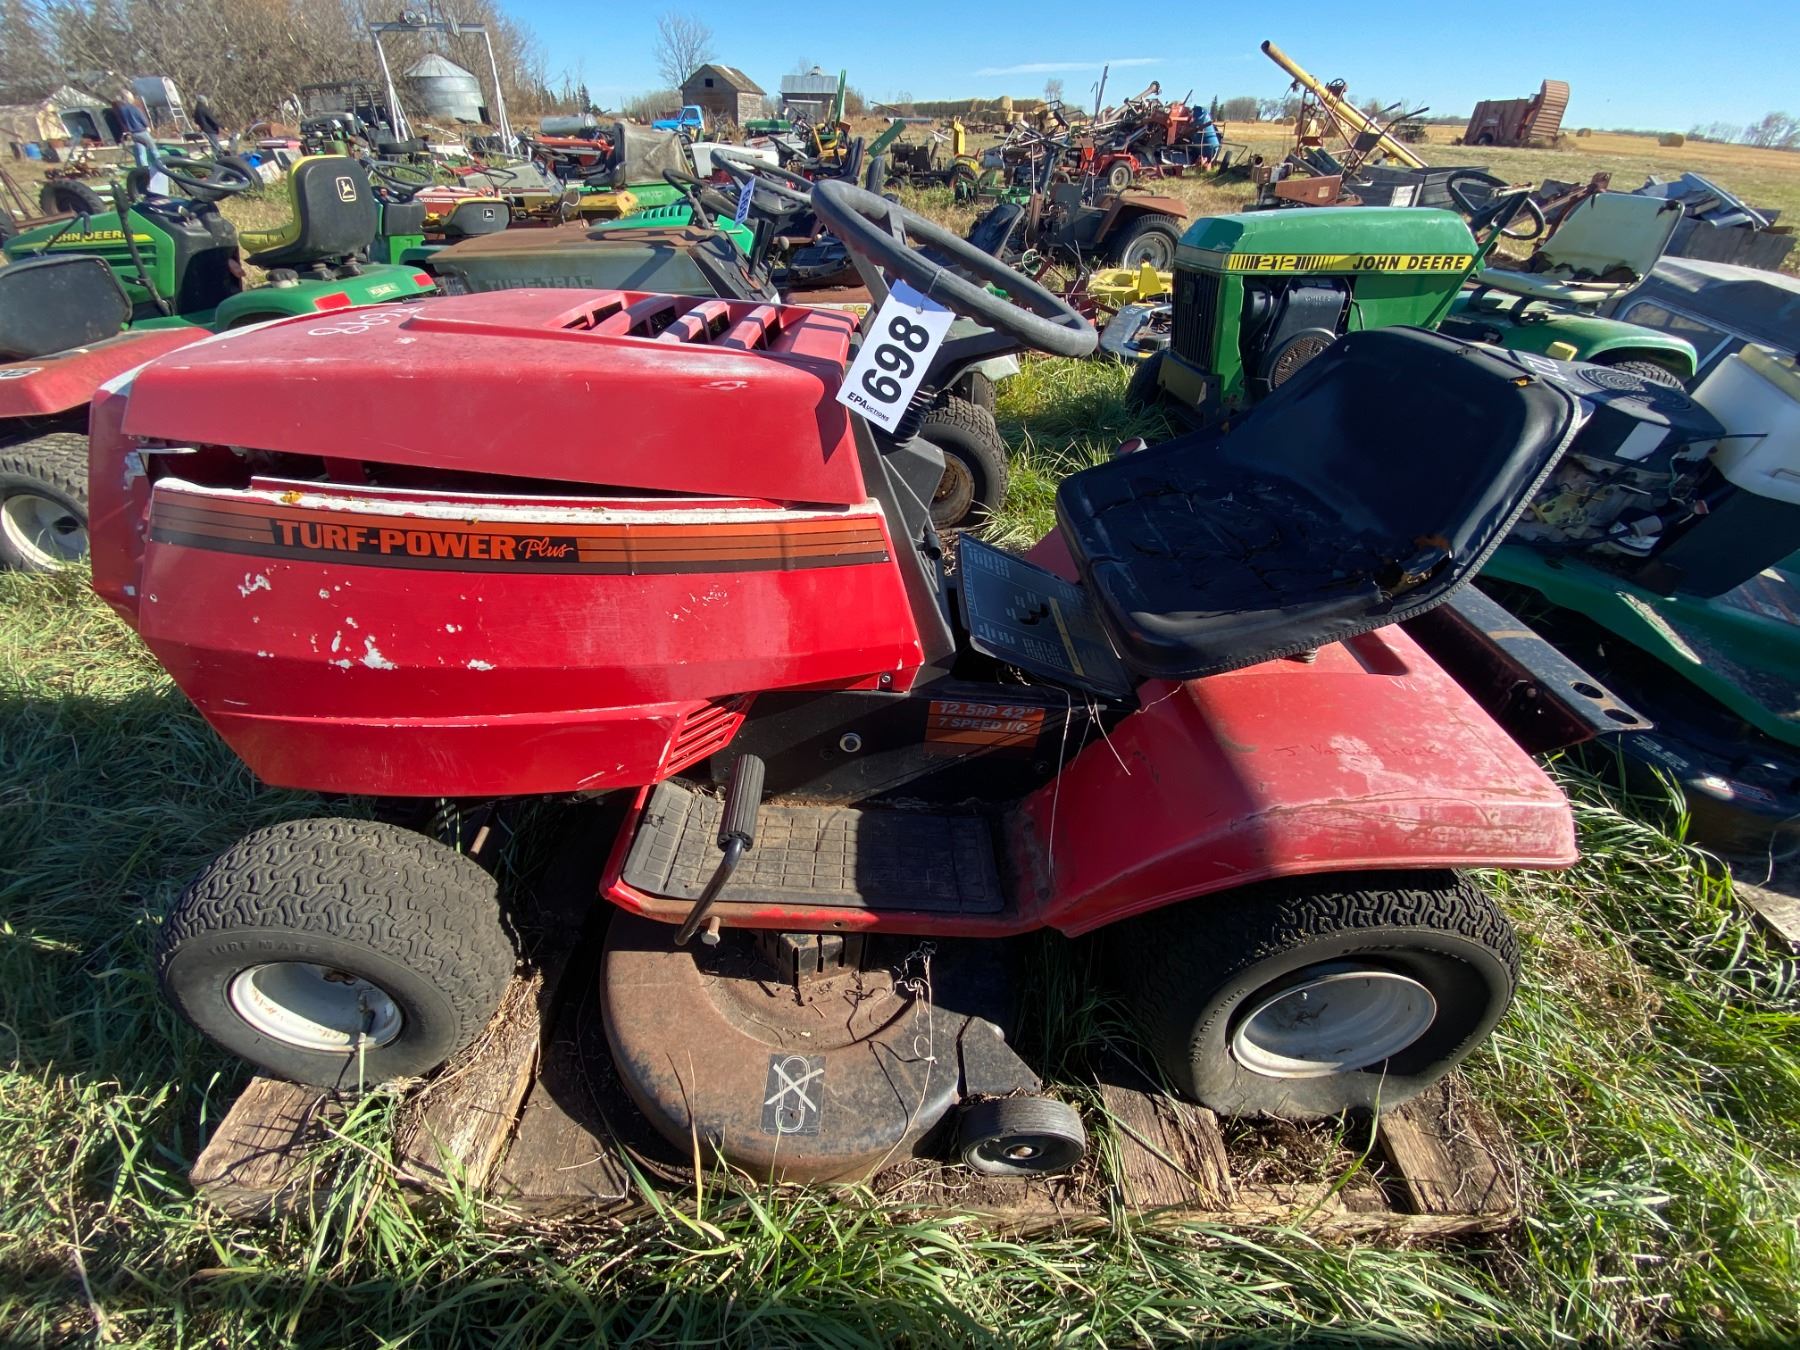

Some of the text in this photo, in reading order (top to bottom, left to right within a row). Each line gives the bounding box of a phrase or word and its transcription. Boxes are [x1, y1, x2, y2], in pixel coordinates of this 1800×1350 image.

[1258, 256, 1298, 270] 212
[1352, 256, 1465, 270] JOHN DEERE
[861, 315, 930, 404] 698
[276, 520, 574, 560] TURF-POWER Plus
[940, 703, 1035, 719] 12.5HP 42"
[951, 718, 1002, 730] SPEED
